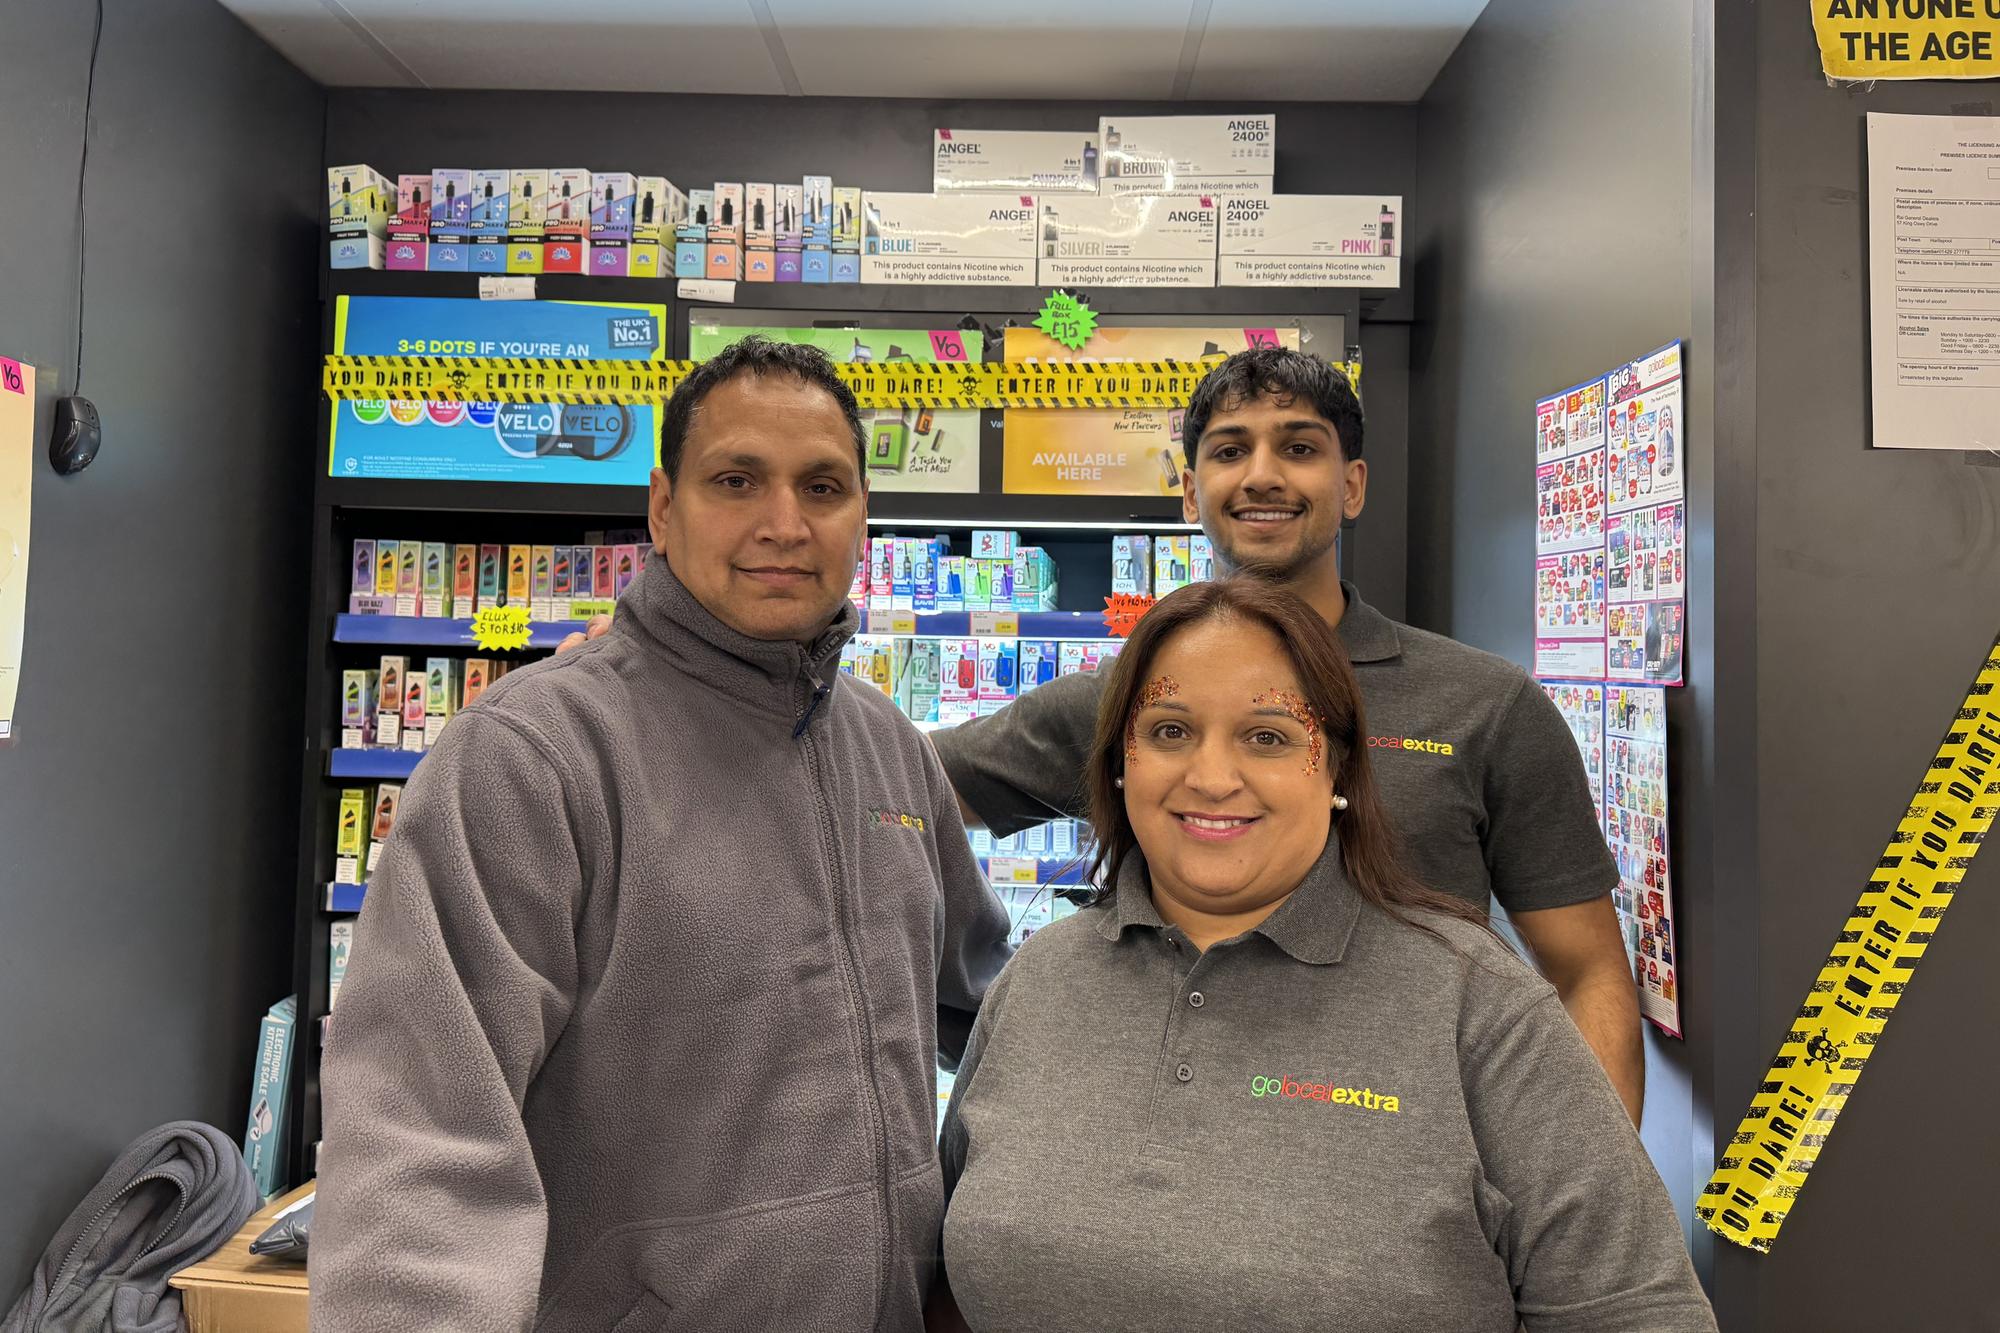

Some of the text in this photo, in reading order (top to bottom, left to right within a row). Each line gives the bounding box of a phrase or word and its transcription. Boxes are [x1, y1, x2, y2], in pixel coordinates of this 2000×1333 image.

[1840, 31, 1992, 61] THE AGE
[1228, 120, 1269, 130] ANGEL
[938, 144, 981, 154] ANGEL
[1113, 184, 1130, 192] This
[1235, 182, 1259, 190] which
[1227, 200, 1270, 210] ANGEL
[989, 210, 1033, 220] ANGEL
[1168, 211, 1213, 222] ANGEL
[882, 239, 912, 252] BLUE
[1060, 241, 1100, 256] SILVER
[1342, 239, 1371, 254] PINK
[873, 261, 1024, 272] This product contains Nicotine which
[1051, 264, 1203, 274] This product contains Nicotine which
[1235, 262, 1385, 271] This product contains Nicotine which
[901, 272, 925, 282] highly
[928, 272, 965, 280] addictive
[968, 273, 1012, 281] substance.
[1079, 275, 1104, 284] highly
[1262, 273, 1288, 282] highly
[1329, 273, 1373, 281] substance.
[614, 326, 651, 342] No.1
[1053, 320, 1080, 338] £15
[398, 340, 589, 357] 3-6 DOTS IF YOU'RE AN
[330, 370, 364, 386] YOU
[376, 371, 432, 387] DARE!
[486, 372, 546, 390] ENTER
[557, 374, 573, 390] IF
[585, 375, 619, 390] YOU
[887, 378, 943, 394] DARE!
[997, 378, 1056, 394] ENTER
[1068, 378, 1084, 393] IF
[1095, 377, 1130, 393] YOU
[500, 413, 553, 430] VELO
[566, 415, 620, 432] VELO
[1032, 453, 1127, 467] AVAILABLE
[1057, 467, 1102, 480] HERE
[1722, 1187, 1759, 1232] OU
[1748, 1085, 1814, 1182] DARE!
[1834, 919, 1901, 1017] ENTER
[1890, 877, 1922, 911] IF
[1910, 810, 1957, 870] YOU
[259, 1026, 275, 1096] KITCHEN SCALE
[270, 1027, 285, 1083] ELECTRONIC
